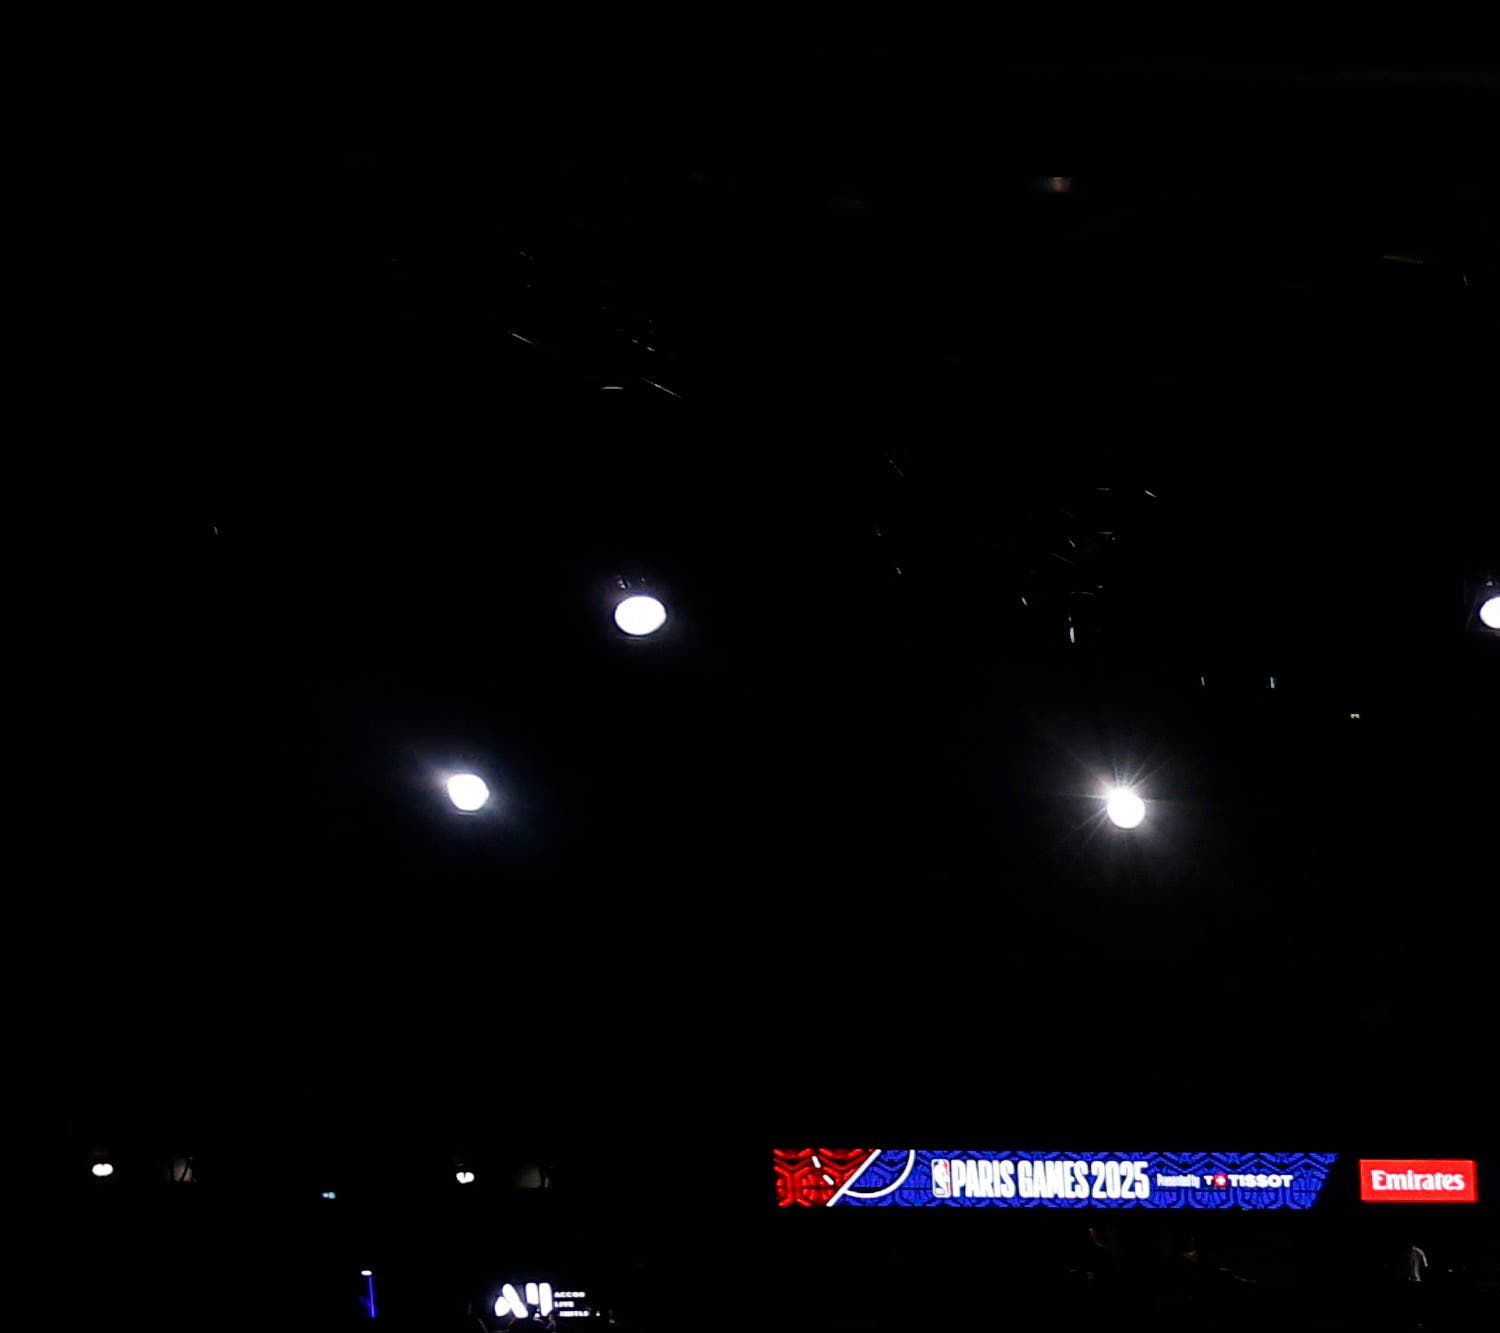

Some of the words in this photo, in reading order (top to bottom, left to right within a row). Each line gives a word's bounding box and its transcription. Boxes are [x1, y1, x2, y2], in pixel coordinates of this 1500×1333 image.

[951, 1159, 1016, 1198] PARIS
[1017, 1160, 1090, 1199] GAMES
[1090, 1160, 1150, 1200] 2025
[1228, 1174, 1294, 1188] TISSOT
[1371, 1169, 1465, 1191] Emirates
